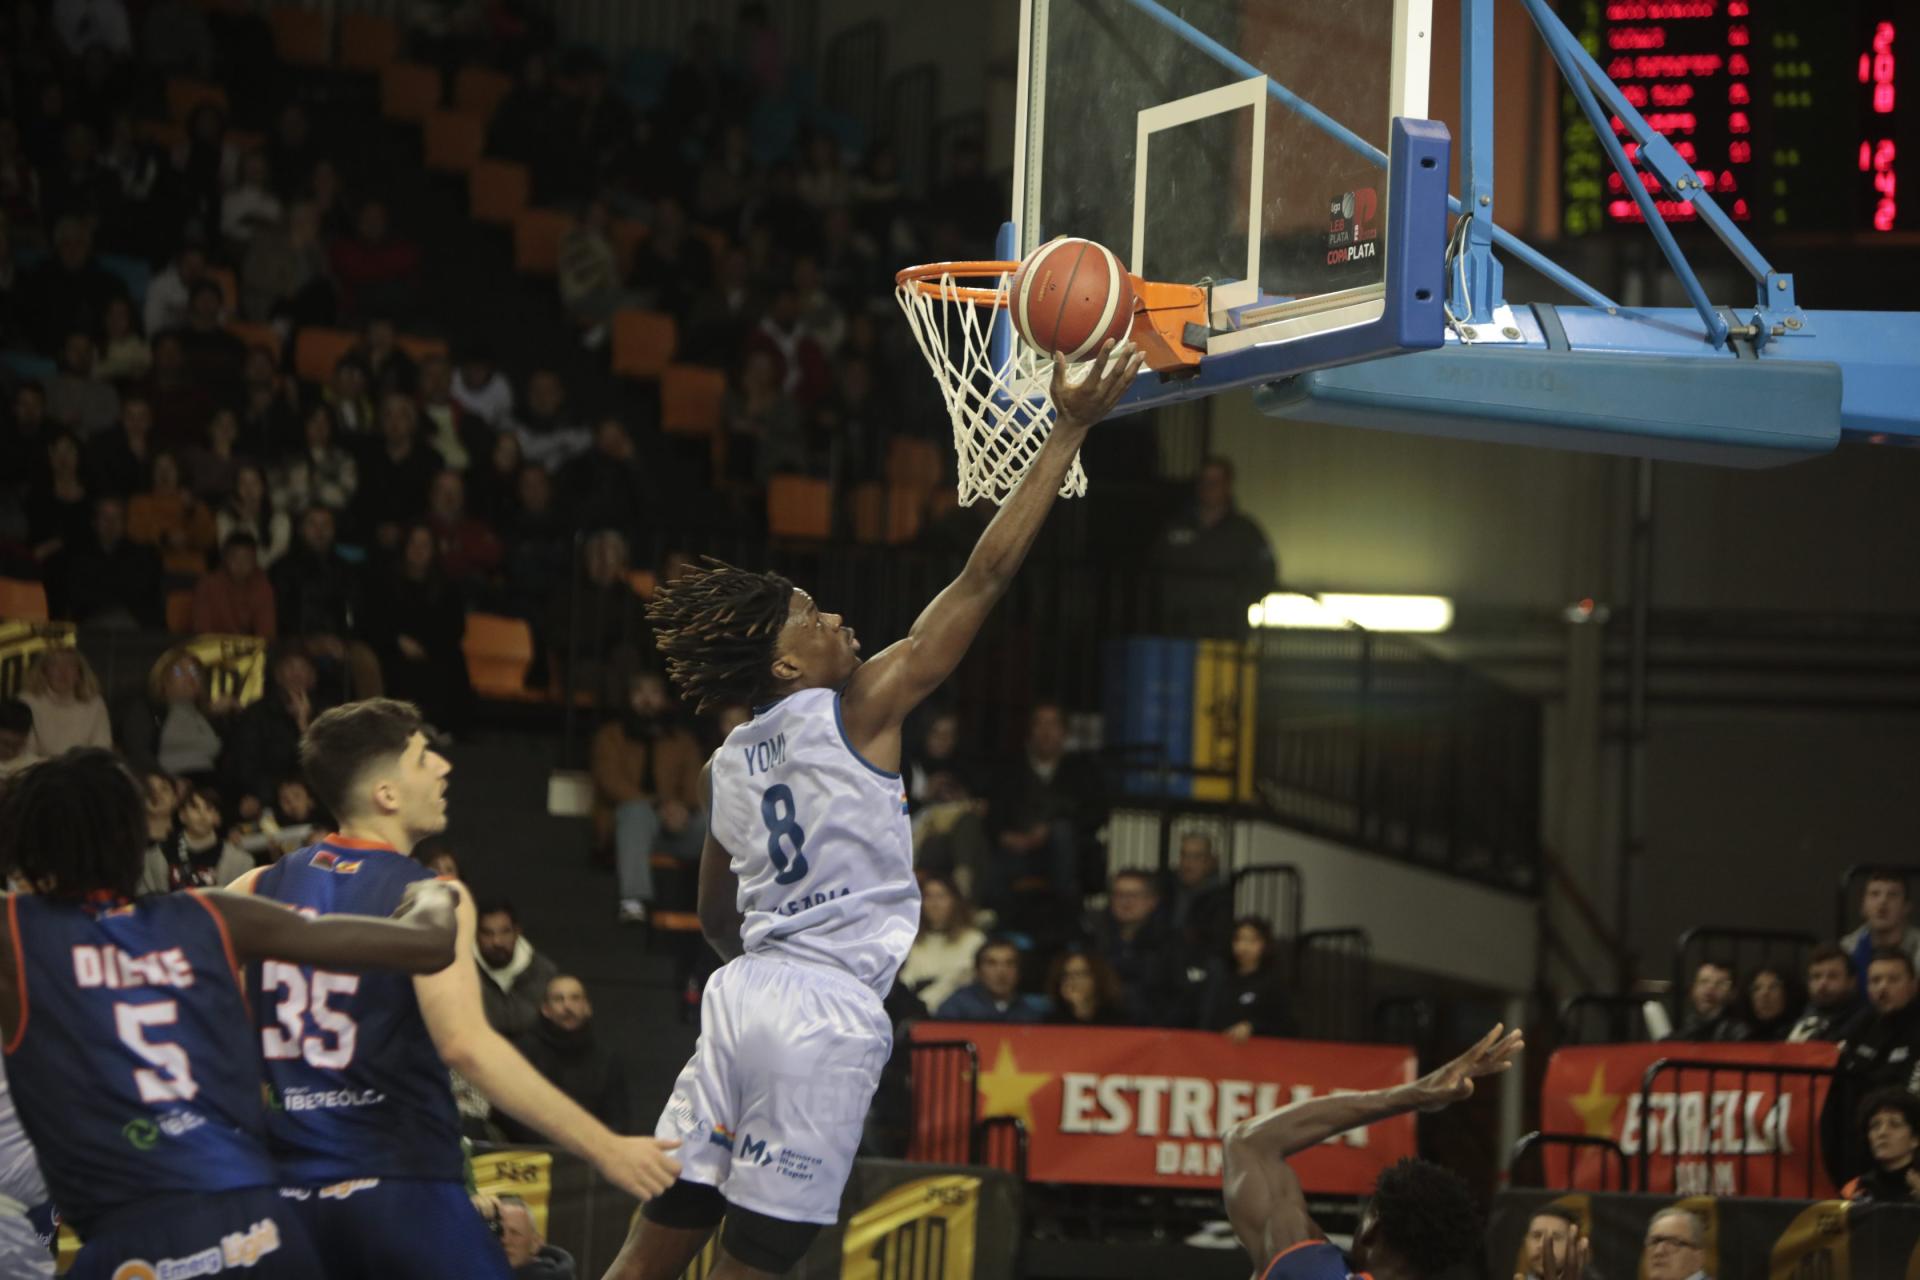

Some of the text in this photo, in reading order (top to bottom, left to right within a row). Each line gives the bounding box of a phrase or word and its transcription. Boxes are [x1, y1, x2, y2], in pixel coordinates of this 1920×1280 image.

[1329, 231, 1349, 244] PLATA
[1330, 219, 1345, 232] LEB
[744, 733, 786, 776] YOMI
[761, 783, 809, 885] 8
[262, 959, 360, 1071] 35
[113, 999, 199, 1104] 5
[782, 1148, 822, 1165] Menorca
